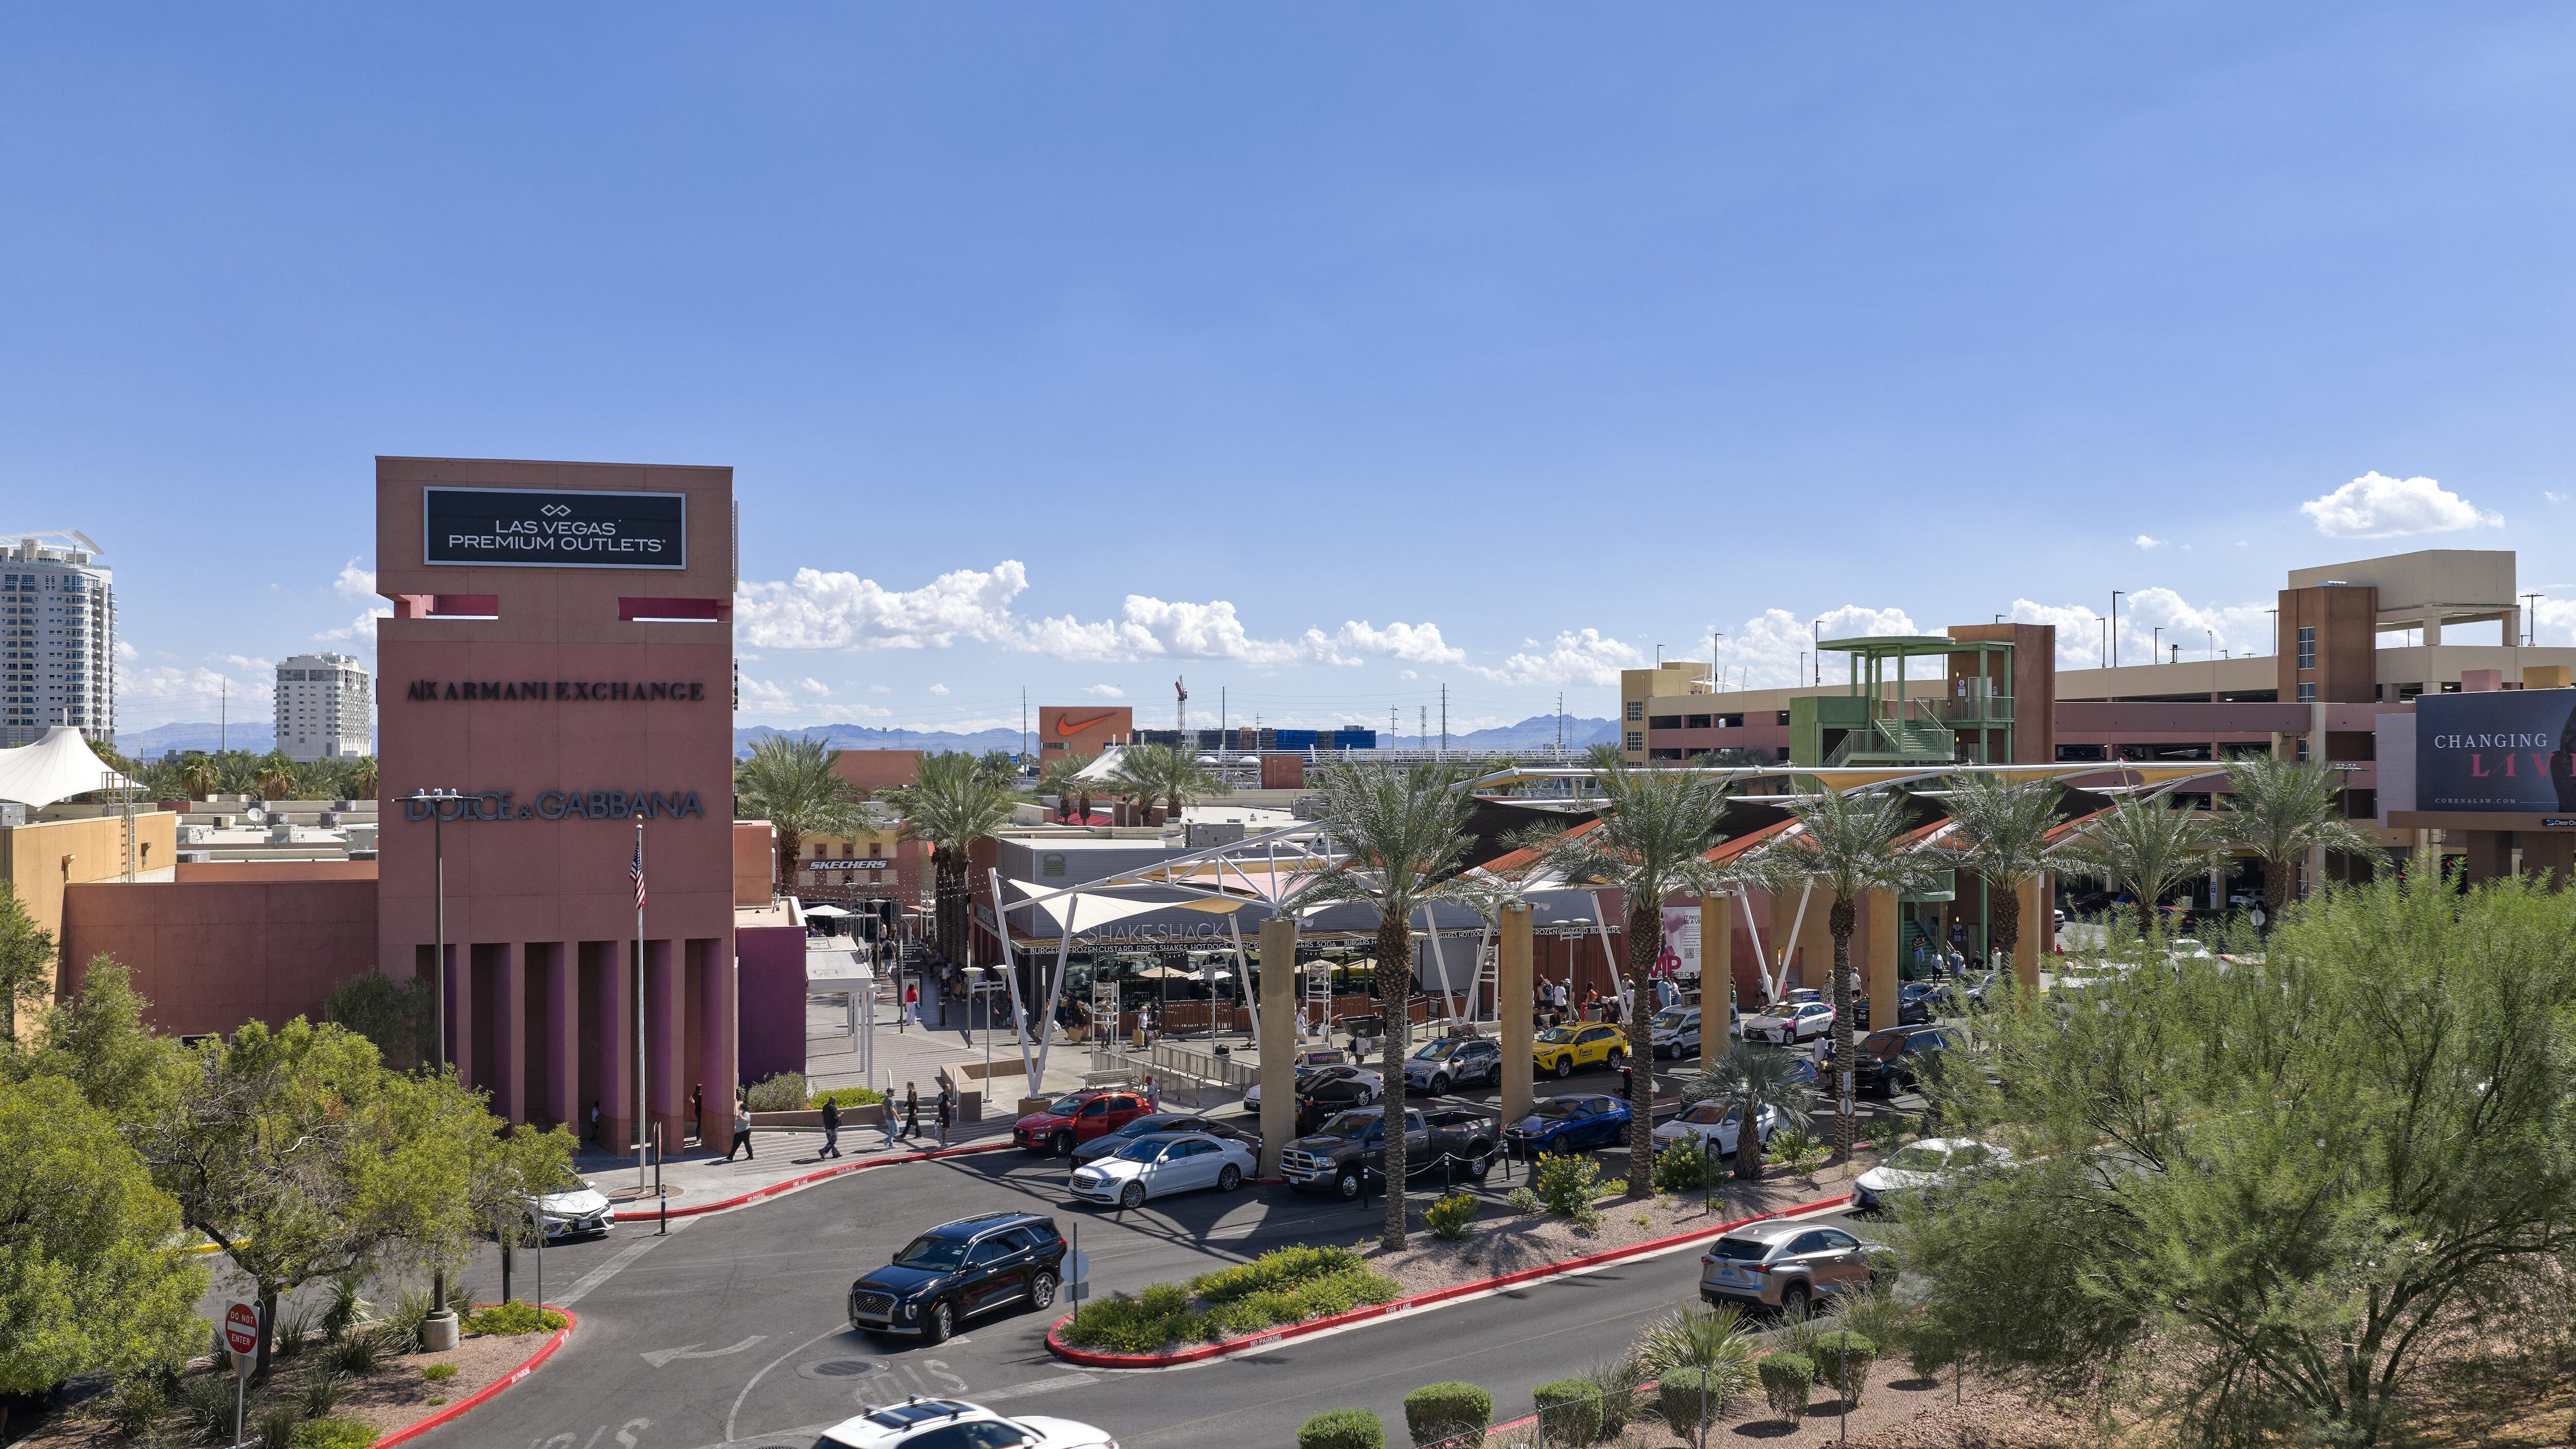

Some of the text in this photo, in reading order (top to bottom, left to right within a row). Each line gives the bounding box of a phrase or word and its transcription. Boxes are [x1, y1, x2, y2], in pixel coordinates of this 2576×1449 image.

[496, 520, 616, 536] LAS VEGAS
[449, 535, 554, 550] PREMIUM
[444, 681, 549, 701] ARMANI
[554, 681, 705, 701] EXCHANGE
[2434, 733, 2548, 749] CHANGING
[407, 790, 705, 821] DOLCE & GABBANA
[809, 860, 888, 870] SKECHERS
[1086, 923, 1224, 943] SHAKE SHACK
[1386, 1302, 1412, 1314] FIRE LANE
[231, 1311, 254, 1324] DO NOT
[231, 1334, 250, 1346] ENTER
[1259, 1334, 1282, 1346] PARKING
[511, 1366, 531, 1384] NO PARKING
